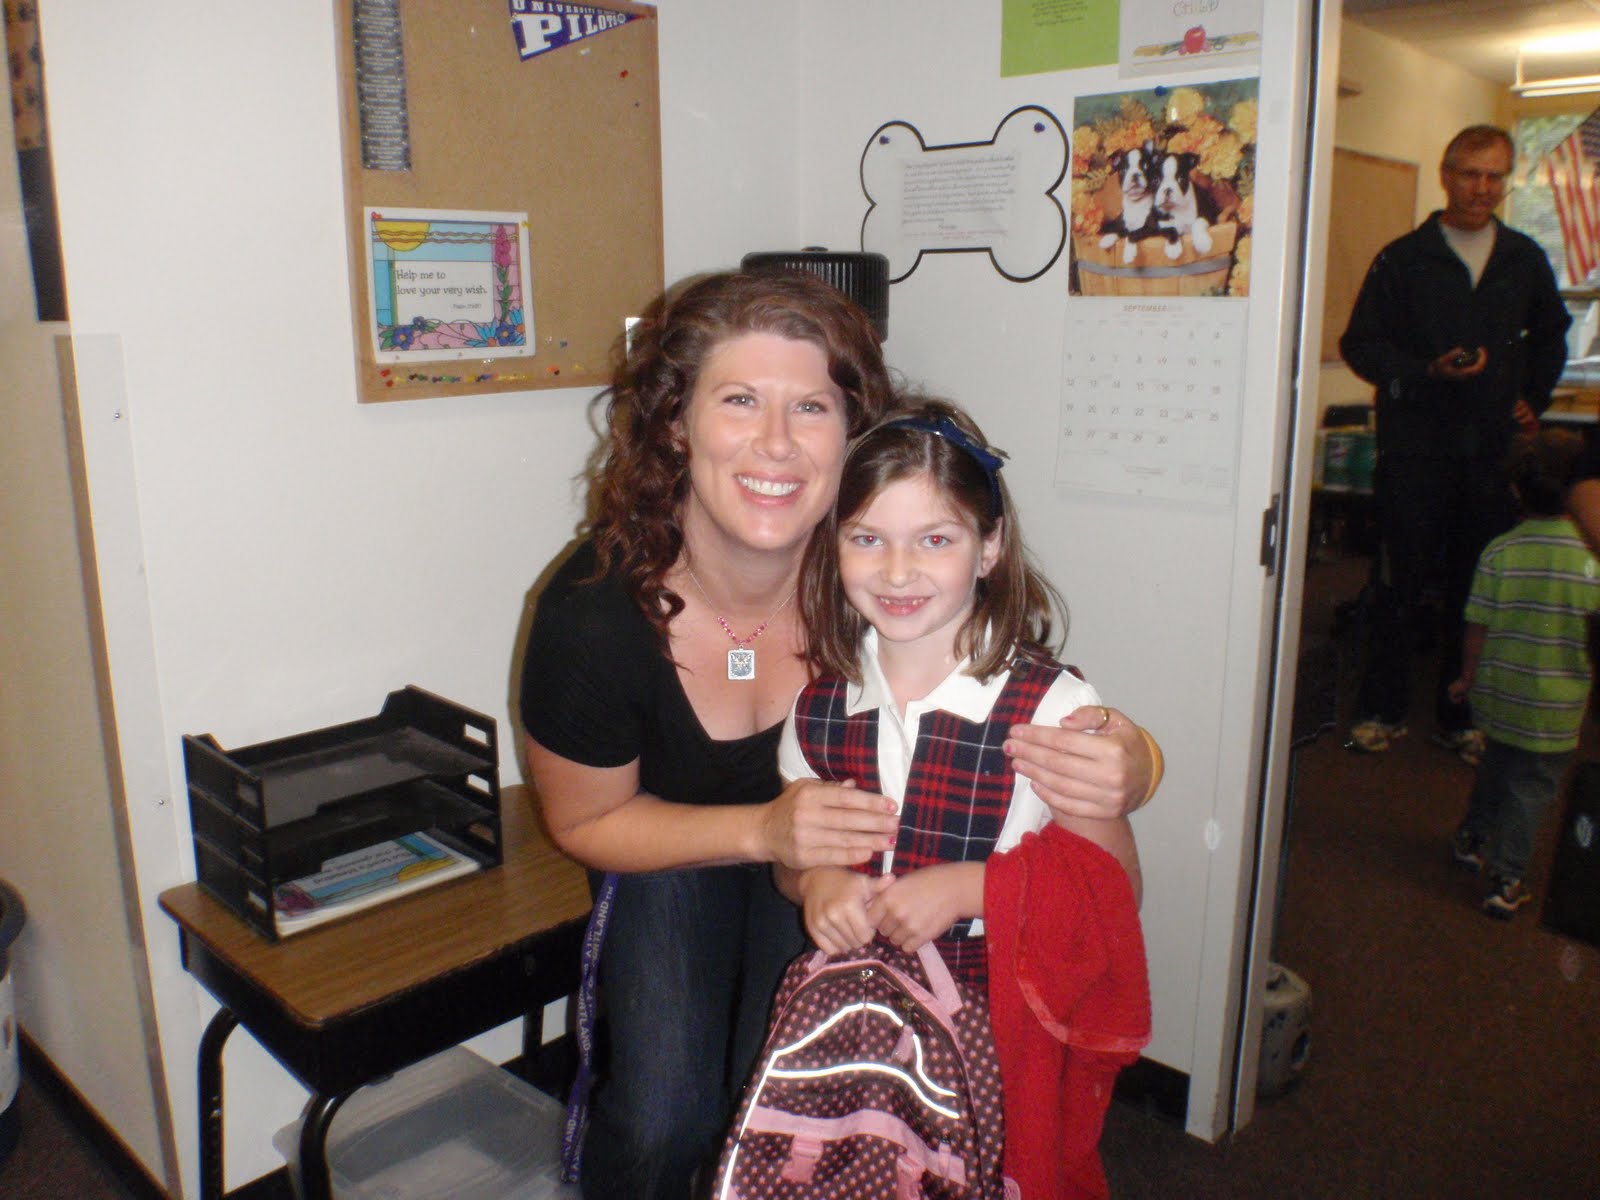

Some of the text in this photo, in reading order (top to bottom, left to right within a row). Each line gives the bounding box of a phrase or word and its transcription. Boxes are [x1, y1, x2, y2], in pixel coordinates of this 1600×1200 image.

[512, 13, 618, 56] PILOTS
[397, 268, 446, 282] Help me to
[397, 285, 488, 297] love your very wish.
